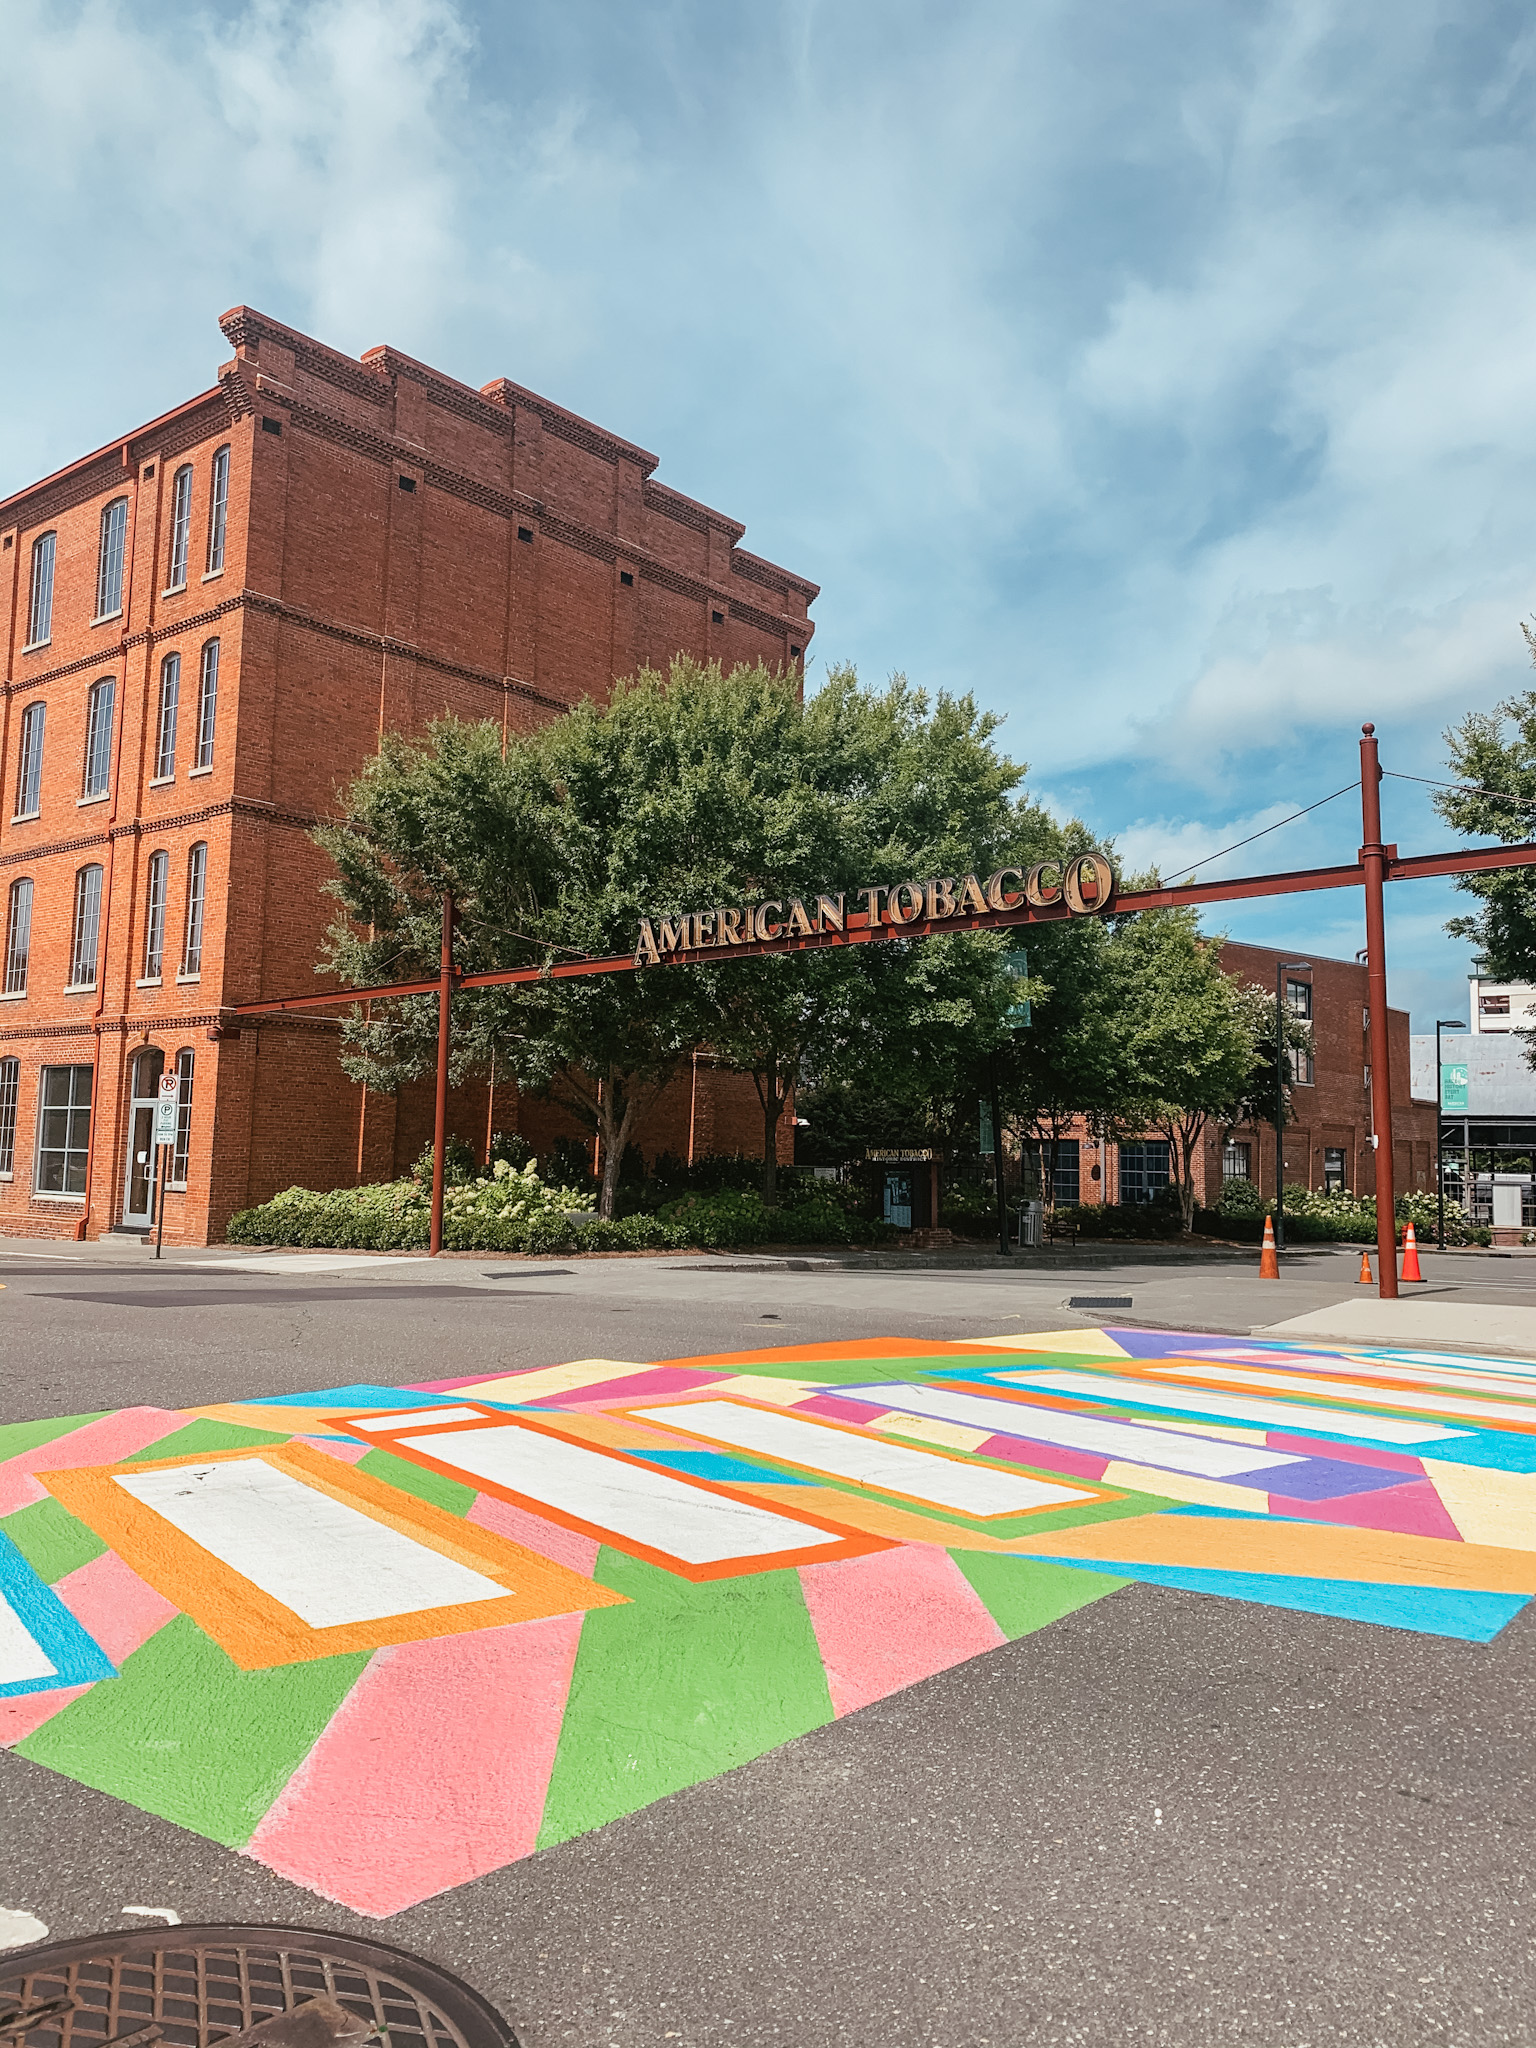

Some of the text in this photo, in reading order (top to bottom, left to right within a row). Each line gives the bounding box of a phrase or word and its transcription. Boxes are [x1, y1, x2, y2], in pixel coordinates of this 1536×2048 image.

[632, 851, 1116, 967] AMERICAN TOBACCO
[865, 1147, 933, 1160] AMERICAN TOBACCO
